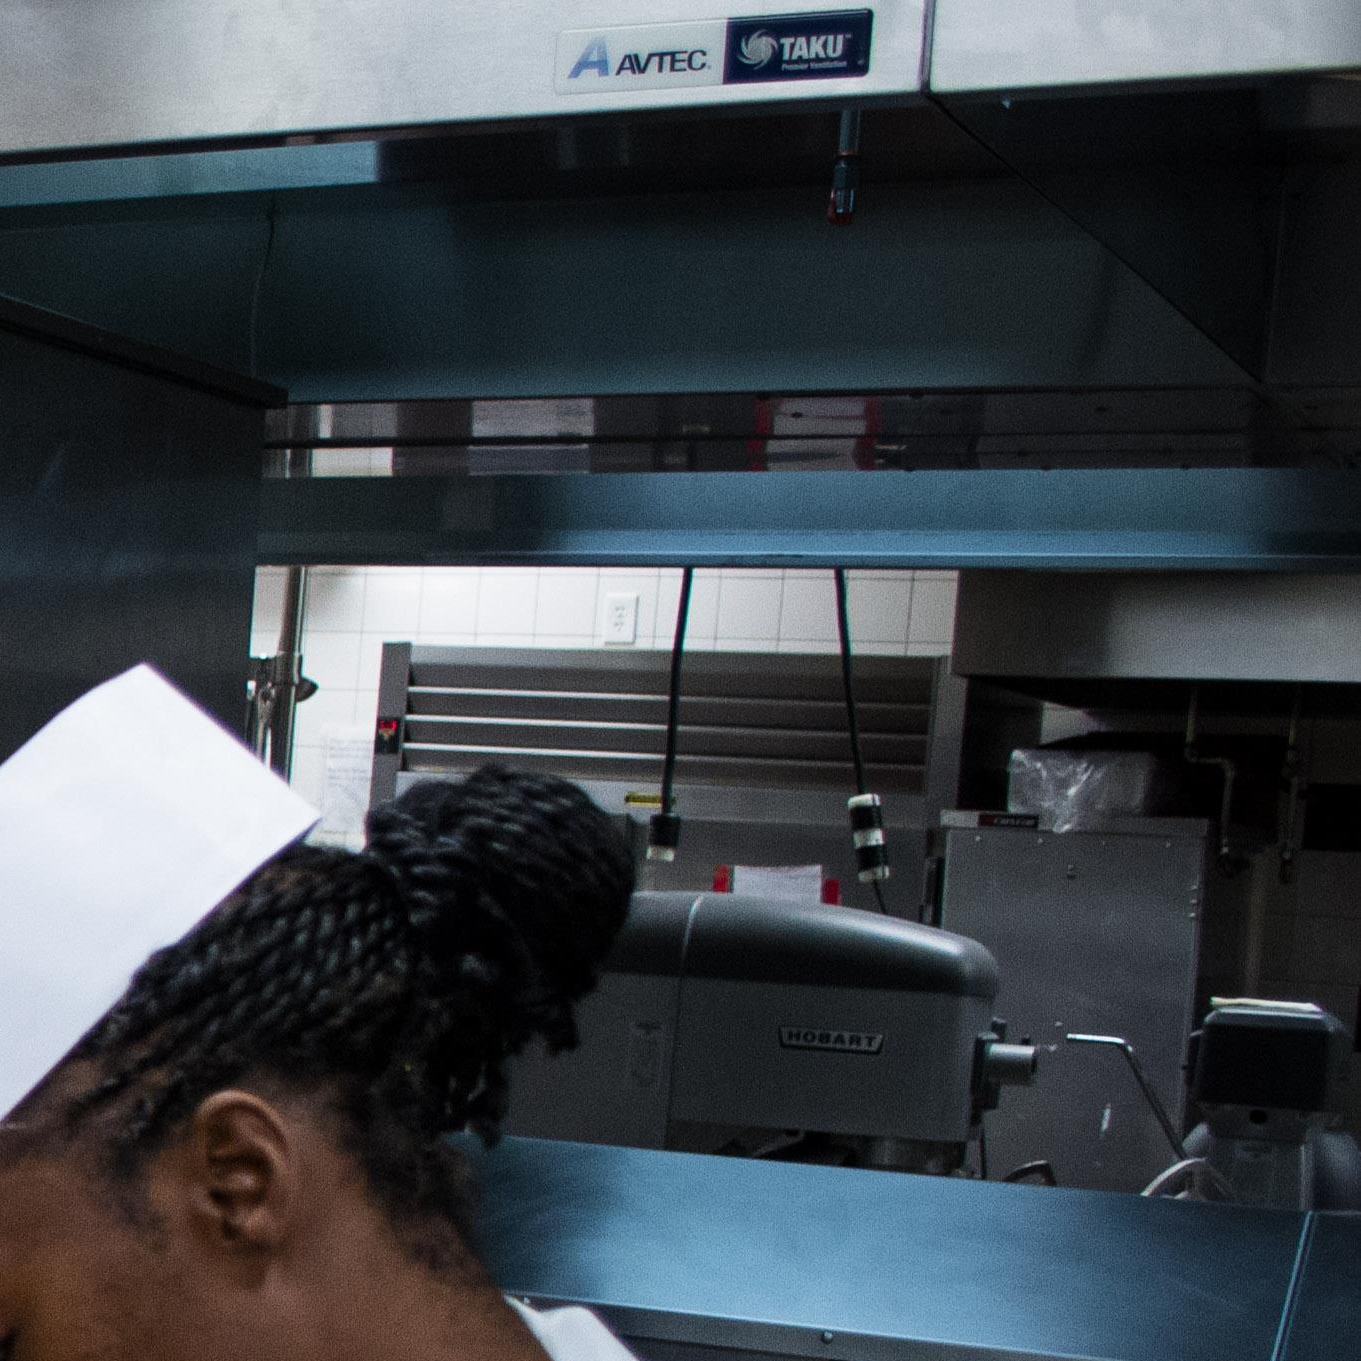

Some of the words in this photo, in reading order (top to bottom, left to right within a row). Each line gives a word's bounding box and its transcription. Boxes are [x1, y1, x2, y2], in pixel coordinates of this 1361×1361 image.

[780, 34, 844, 61] TAKU
[615, 49, 707, 76] AVTEC
[787, 1030, 877, 1048] HOBART
